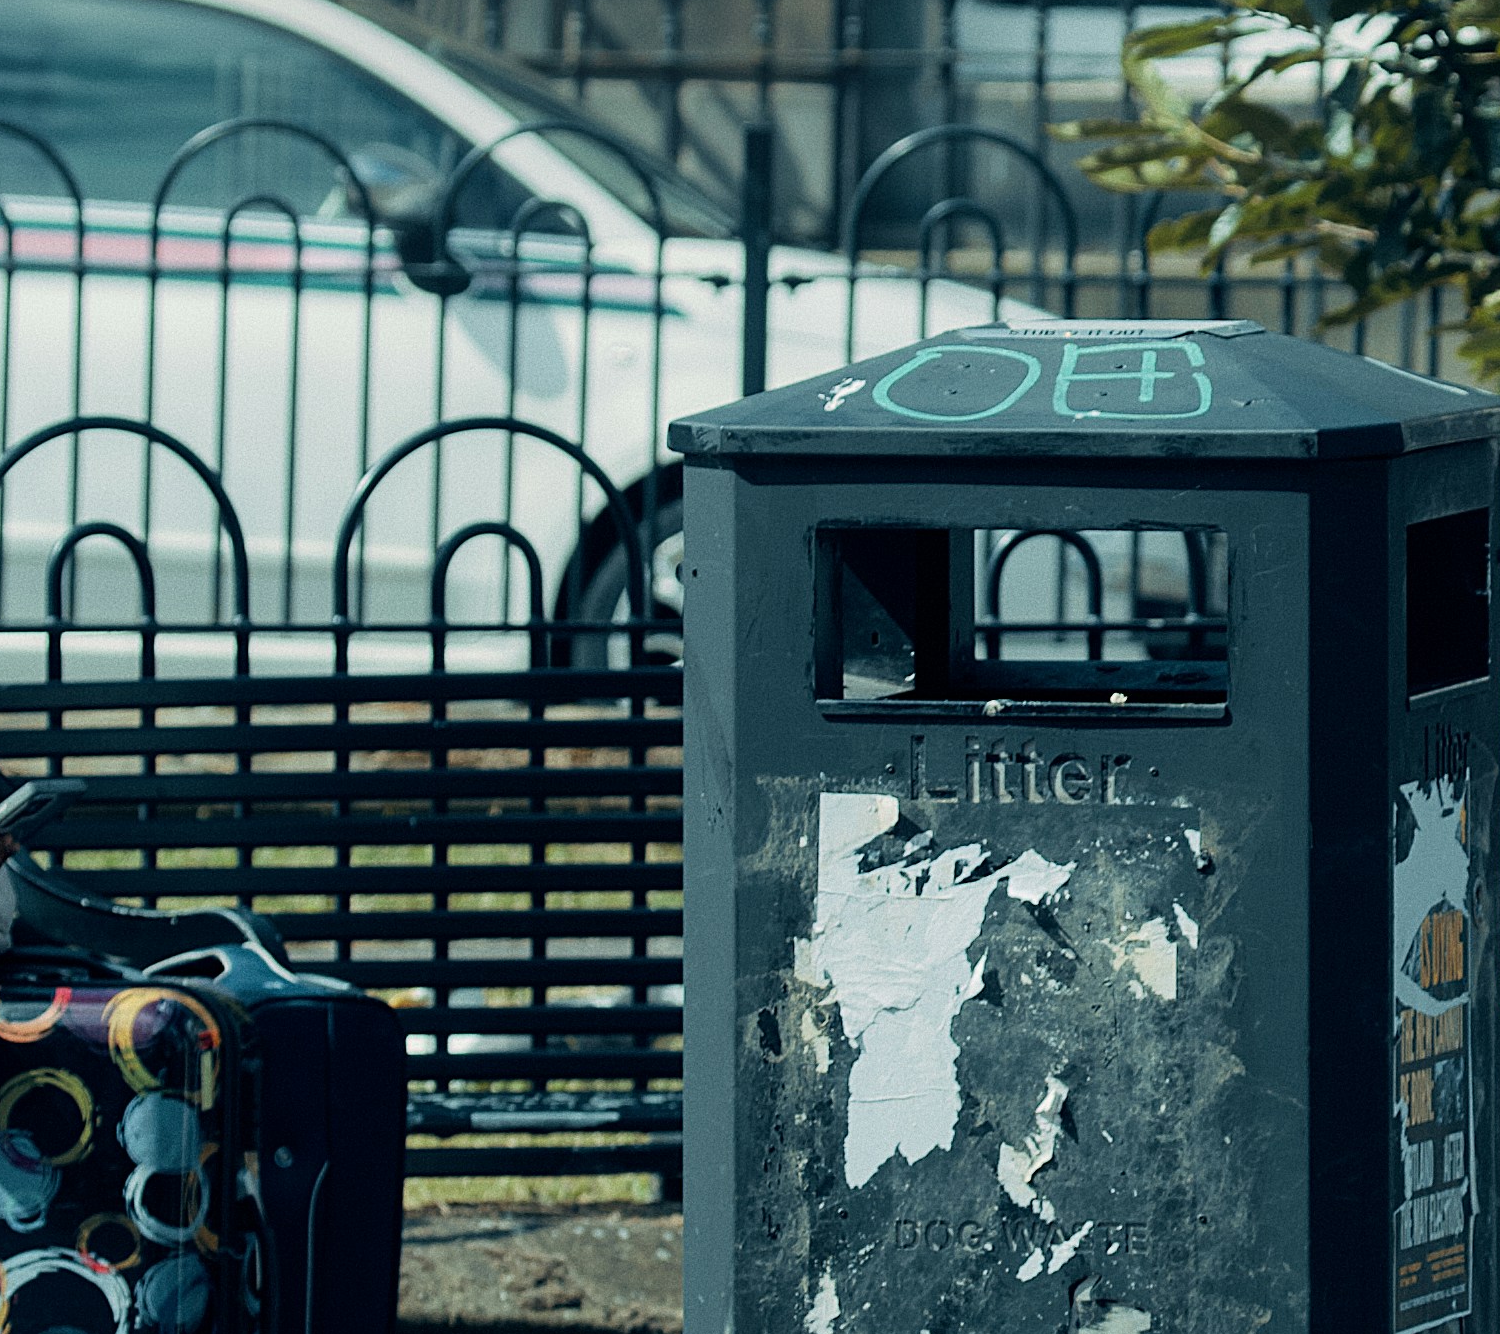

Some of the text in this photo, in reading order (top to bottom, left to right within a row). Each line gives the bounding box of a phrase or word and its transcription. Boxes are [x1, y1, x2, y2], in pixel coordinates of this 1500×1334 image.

[909, 733, 1134, 806] Litter
[1423, 722, 1471, 783] Litter
[894, 1218, 986, 1253] DOG
